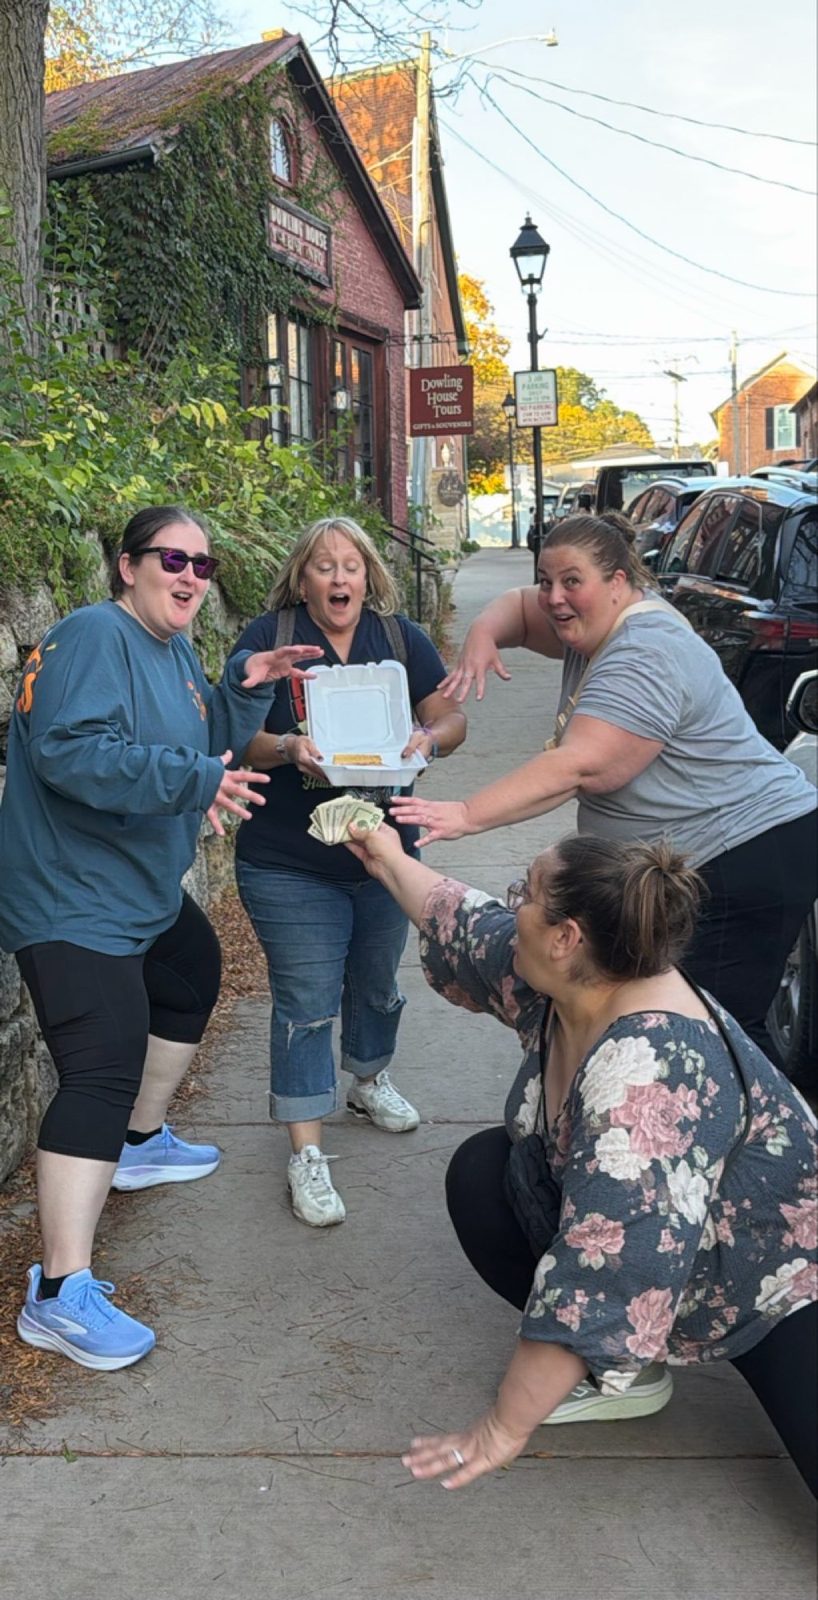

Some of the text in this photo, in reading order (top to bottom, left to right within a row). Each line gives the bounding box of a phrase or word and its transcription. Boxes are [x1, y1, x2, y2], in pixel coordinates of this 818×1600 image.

[269, 203, 303, 239] DOWLING
[305, 222, 328, 251] HOUSE
[421, 373, 463, 392] Dowling
[521, 382, 549, 390] PARKING
[427, 392, 458, 405] House
[432, 405, 462, 418] Tours
